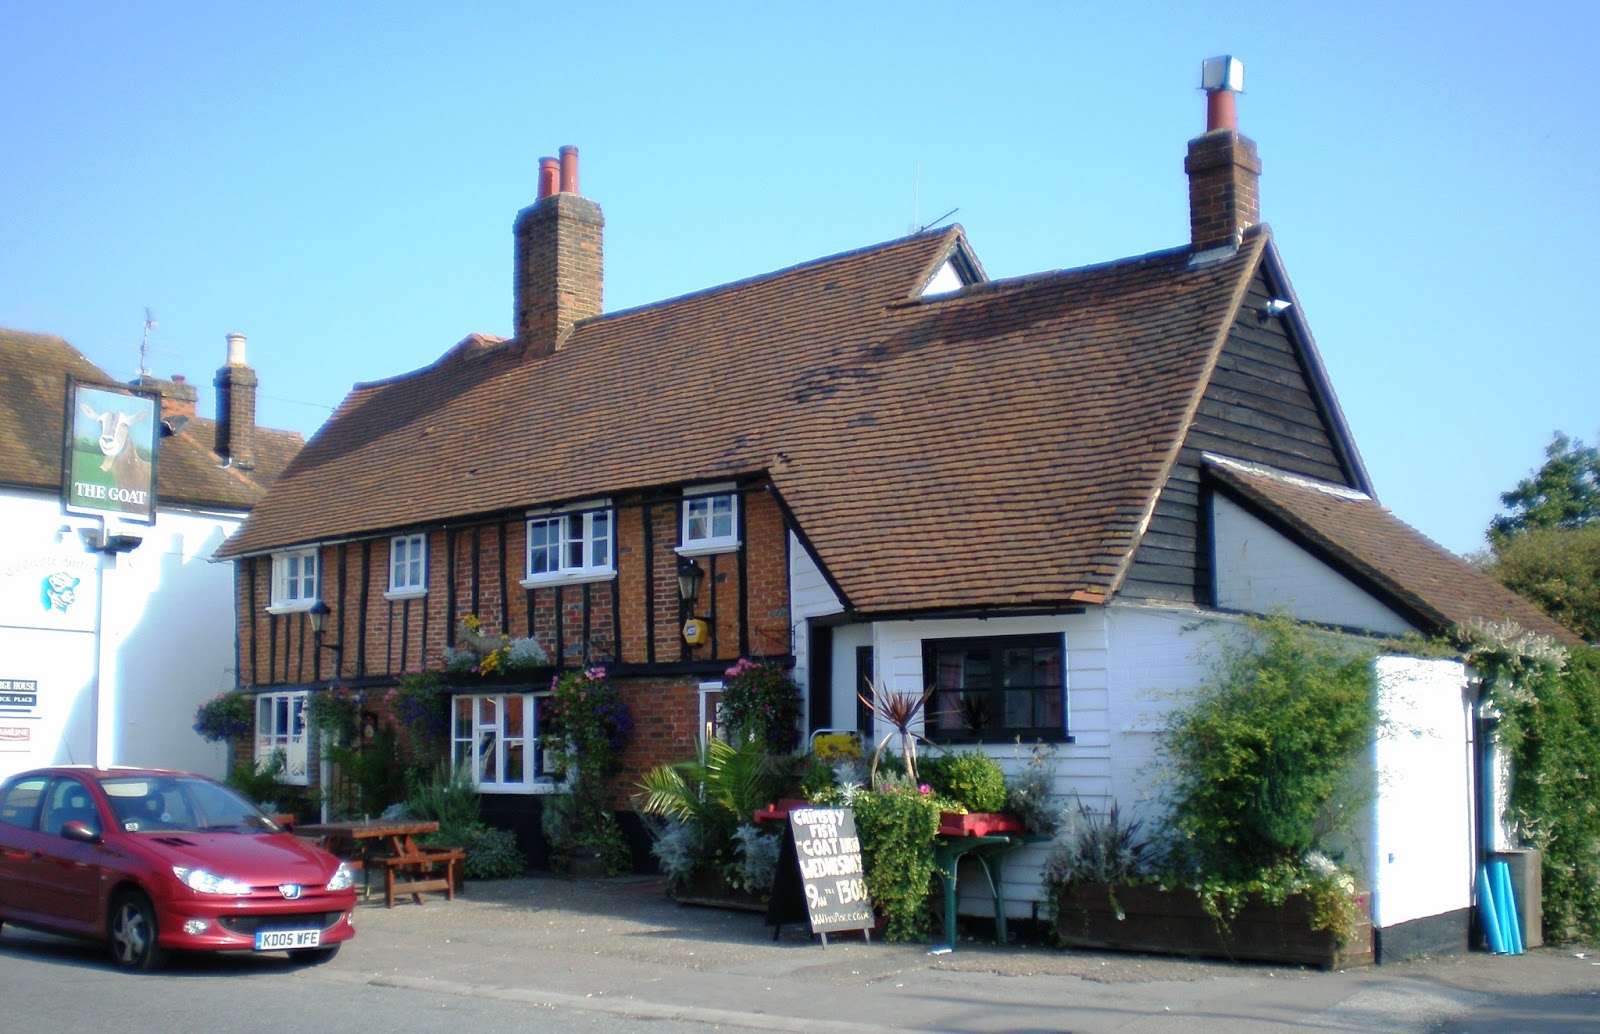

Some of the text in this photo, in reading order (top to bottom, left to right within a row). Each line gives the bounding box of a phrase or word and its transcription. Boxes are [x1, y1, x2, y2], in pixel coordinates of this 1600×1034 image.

[75, 482, 147, 504] THE GOAT
[13, 681, 36, 692] HOUSE
[793, 808, 845, 827] GRIMSBY
[809, 824, 838, 839] FISH
[802, 838, 838, 856] GOAT
[297, 932, 318, 945] WFE
